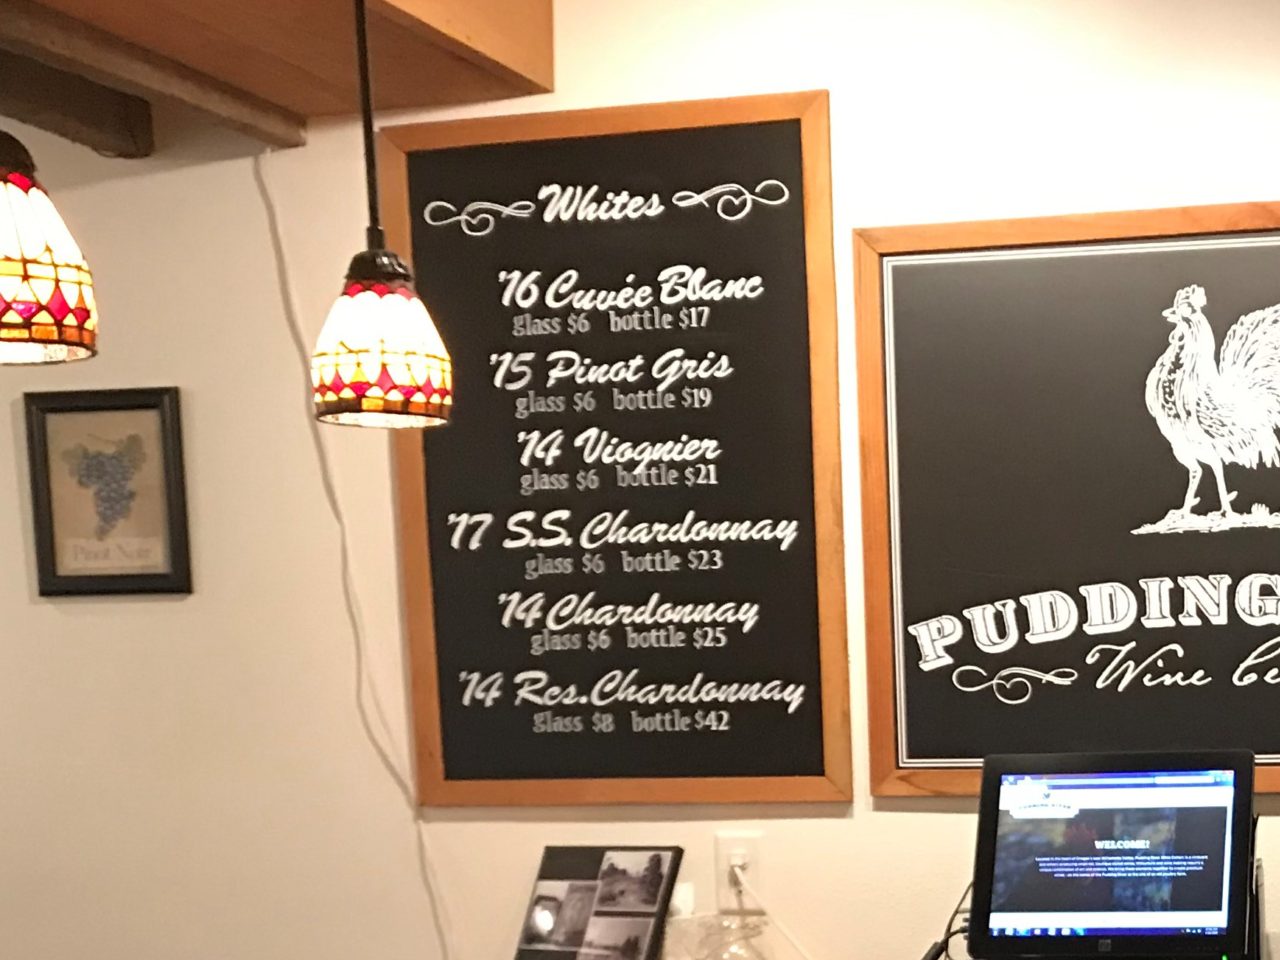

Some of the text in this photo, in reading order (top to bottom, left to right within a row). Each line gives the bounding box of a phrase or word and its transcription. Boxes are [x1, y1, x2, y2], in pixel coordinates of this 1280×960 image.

[538, 184, 665, 222] Whites
[658, 265, 764, 304] Blanc
[513, 307, 710, 336] glass $6 bottle $17
[546, 351, 644, 387] Pinot
[652, 348, 733, 391] Gris
[515, 387, 712, 418] glass $6 bottle $19
[574, 427, 722, 475] Viognier
[520, 464, 719, 496] glass $6 bottle $21
[503, 510, 573, 548] S.S.
[580, 510, 798, 551] Chardonnay
[525, 549, 723, 580] glass $6 bottle $23
[546, 591, 760, 633] Chardonnay
[531, 626, 727, 655] glass $6 bottle $25
[1086, 642, 1212, 692] Wine
[590, 669, 805, 713] Chardonnay
[533, 708, 730, 733] glass $8 bottle $42
